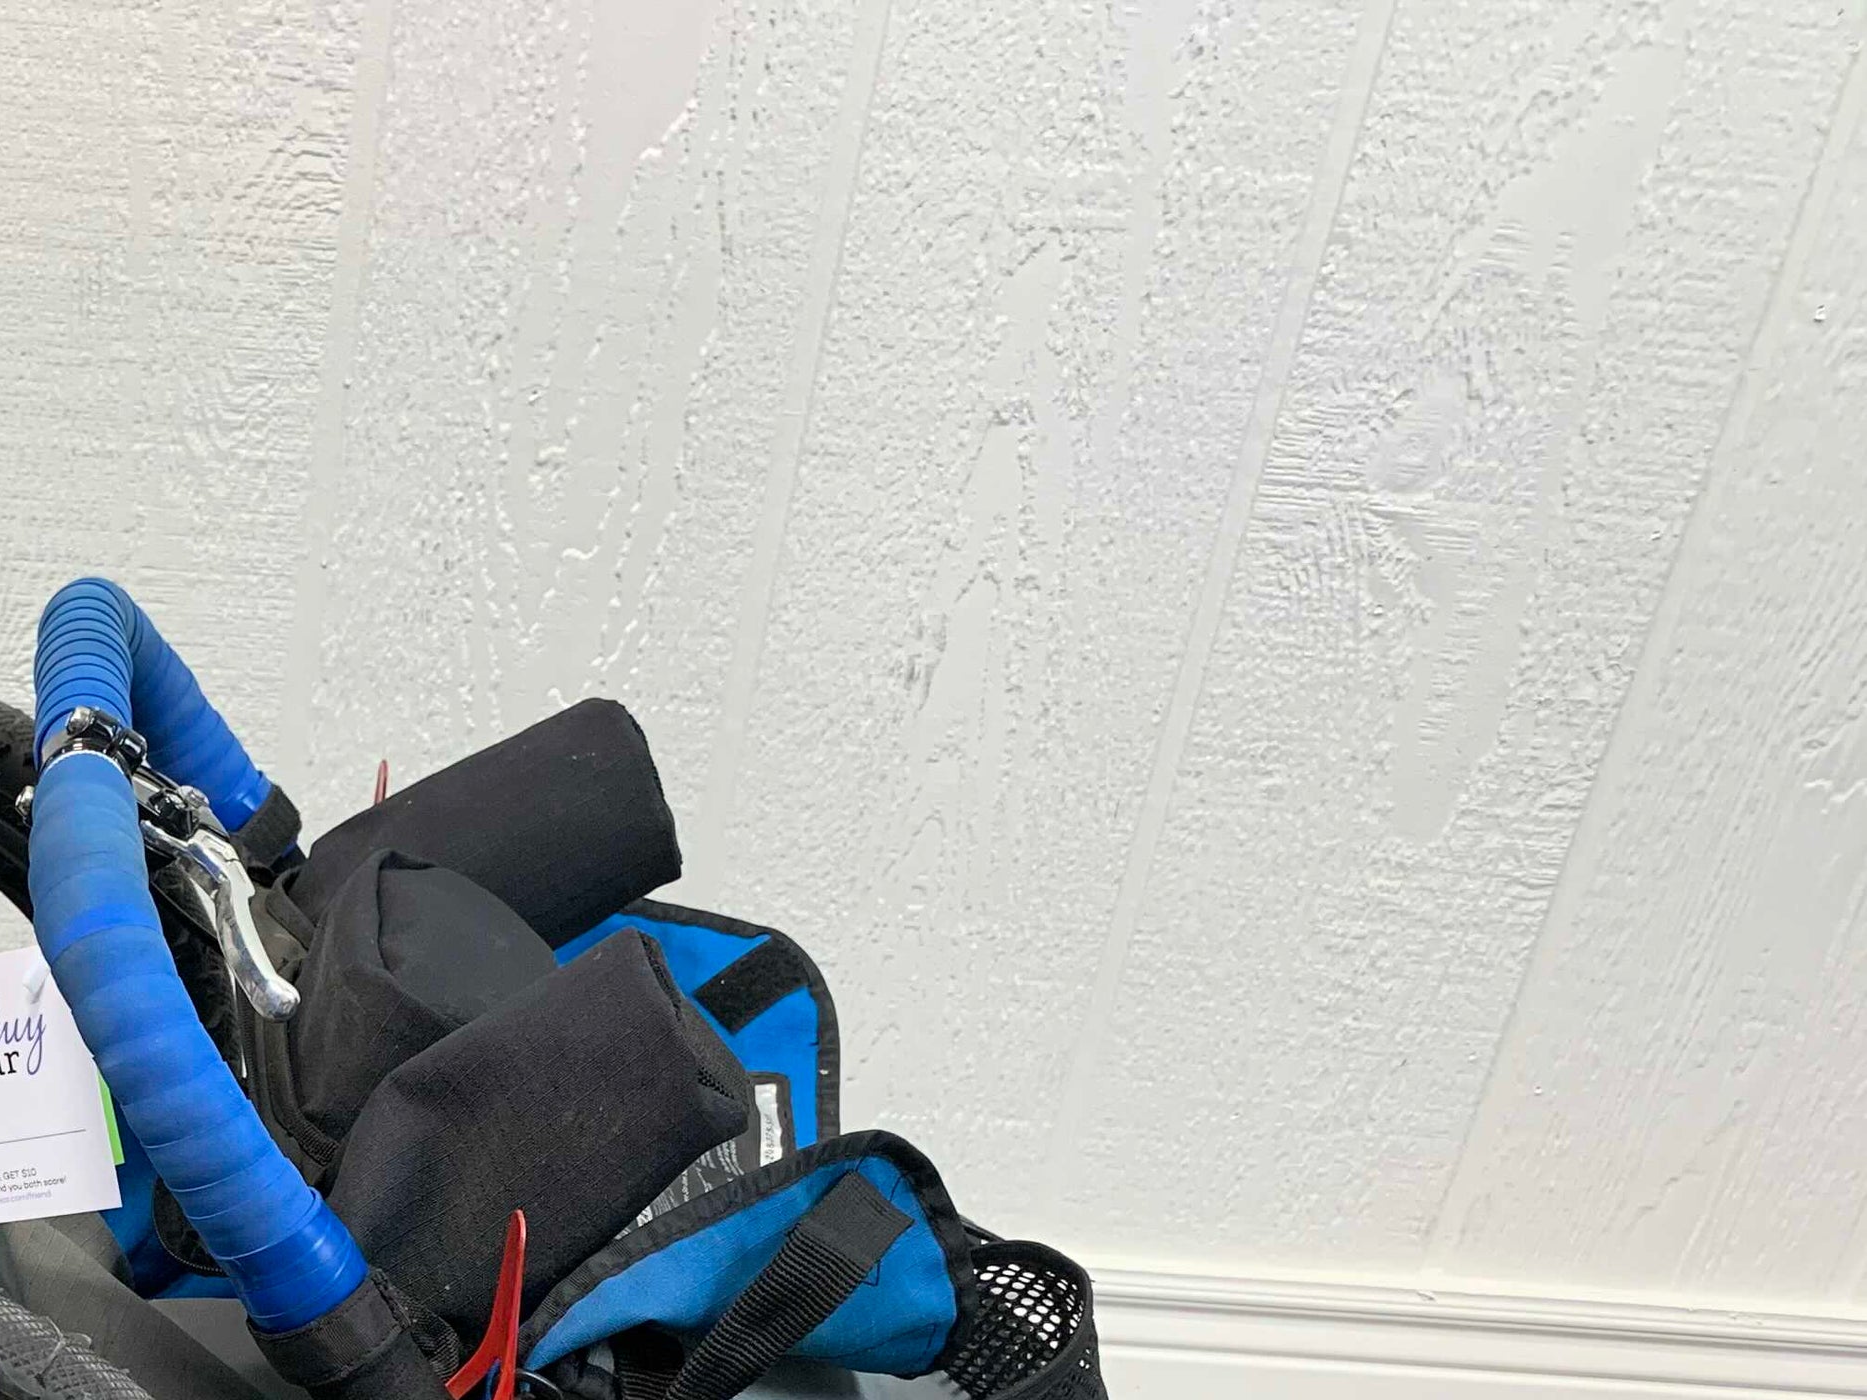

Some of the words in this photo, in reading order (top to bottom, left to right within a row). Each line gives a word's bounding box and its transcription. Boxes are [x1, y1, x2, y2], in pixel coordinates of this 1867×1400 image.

[3, 1169, 19, 1180] GET
[21, 1167, 37, 1178] $10
[8, 1183, 23, 1193] you
[23, 1178, 43, 1189] both
